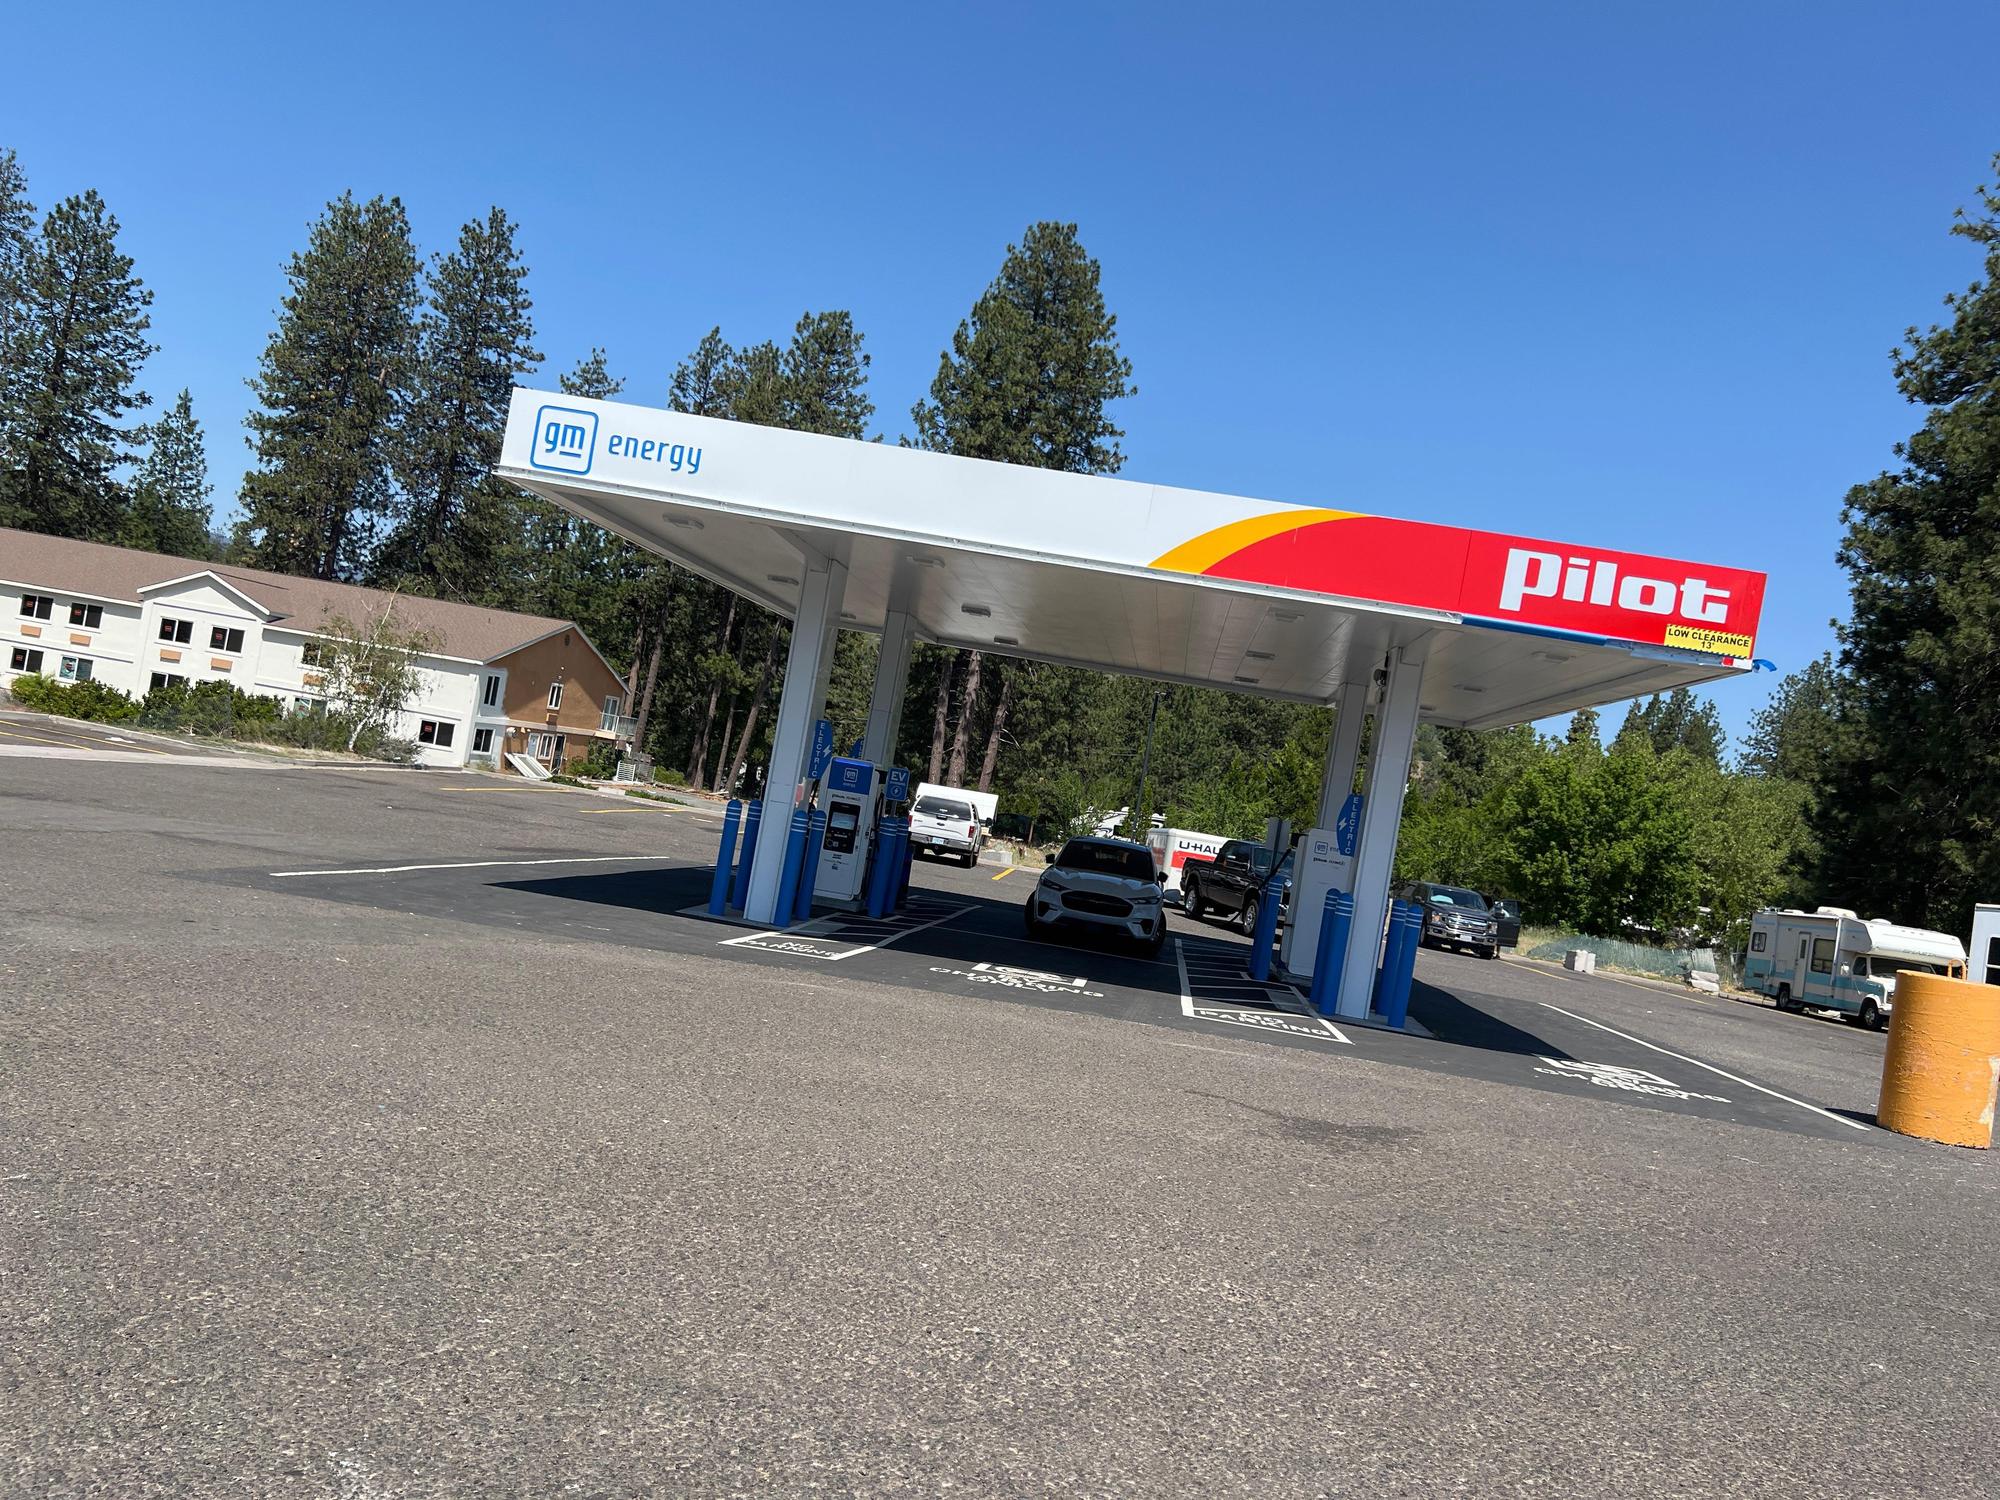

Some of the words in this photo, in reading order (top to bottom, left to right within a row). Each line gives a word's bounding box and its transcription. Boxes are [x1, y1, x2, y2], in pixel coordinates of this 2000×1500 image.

[544, 421, 586, 459] gm
[608, 434, 702, 475] energy
[1668, 628, 1690, 638] LOW
[1691, 631, 1750, 647] CLEARANCE
[811, 722, 826, 777] ELECTRIC
[891, 770, 907, 782] EV
[1344, 796, 1360, 854] ELECTRIC
[929, 966, 1104, 998] CHARGING
[1200, 1010, 1332, 1037] PARKING
[1239, 1012, 1285, 1024] NO
